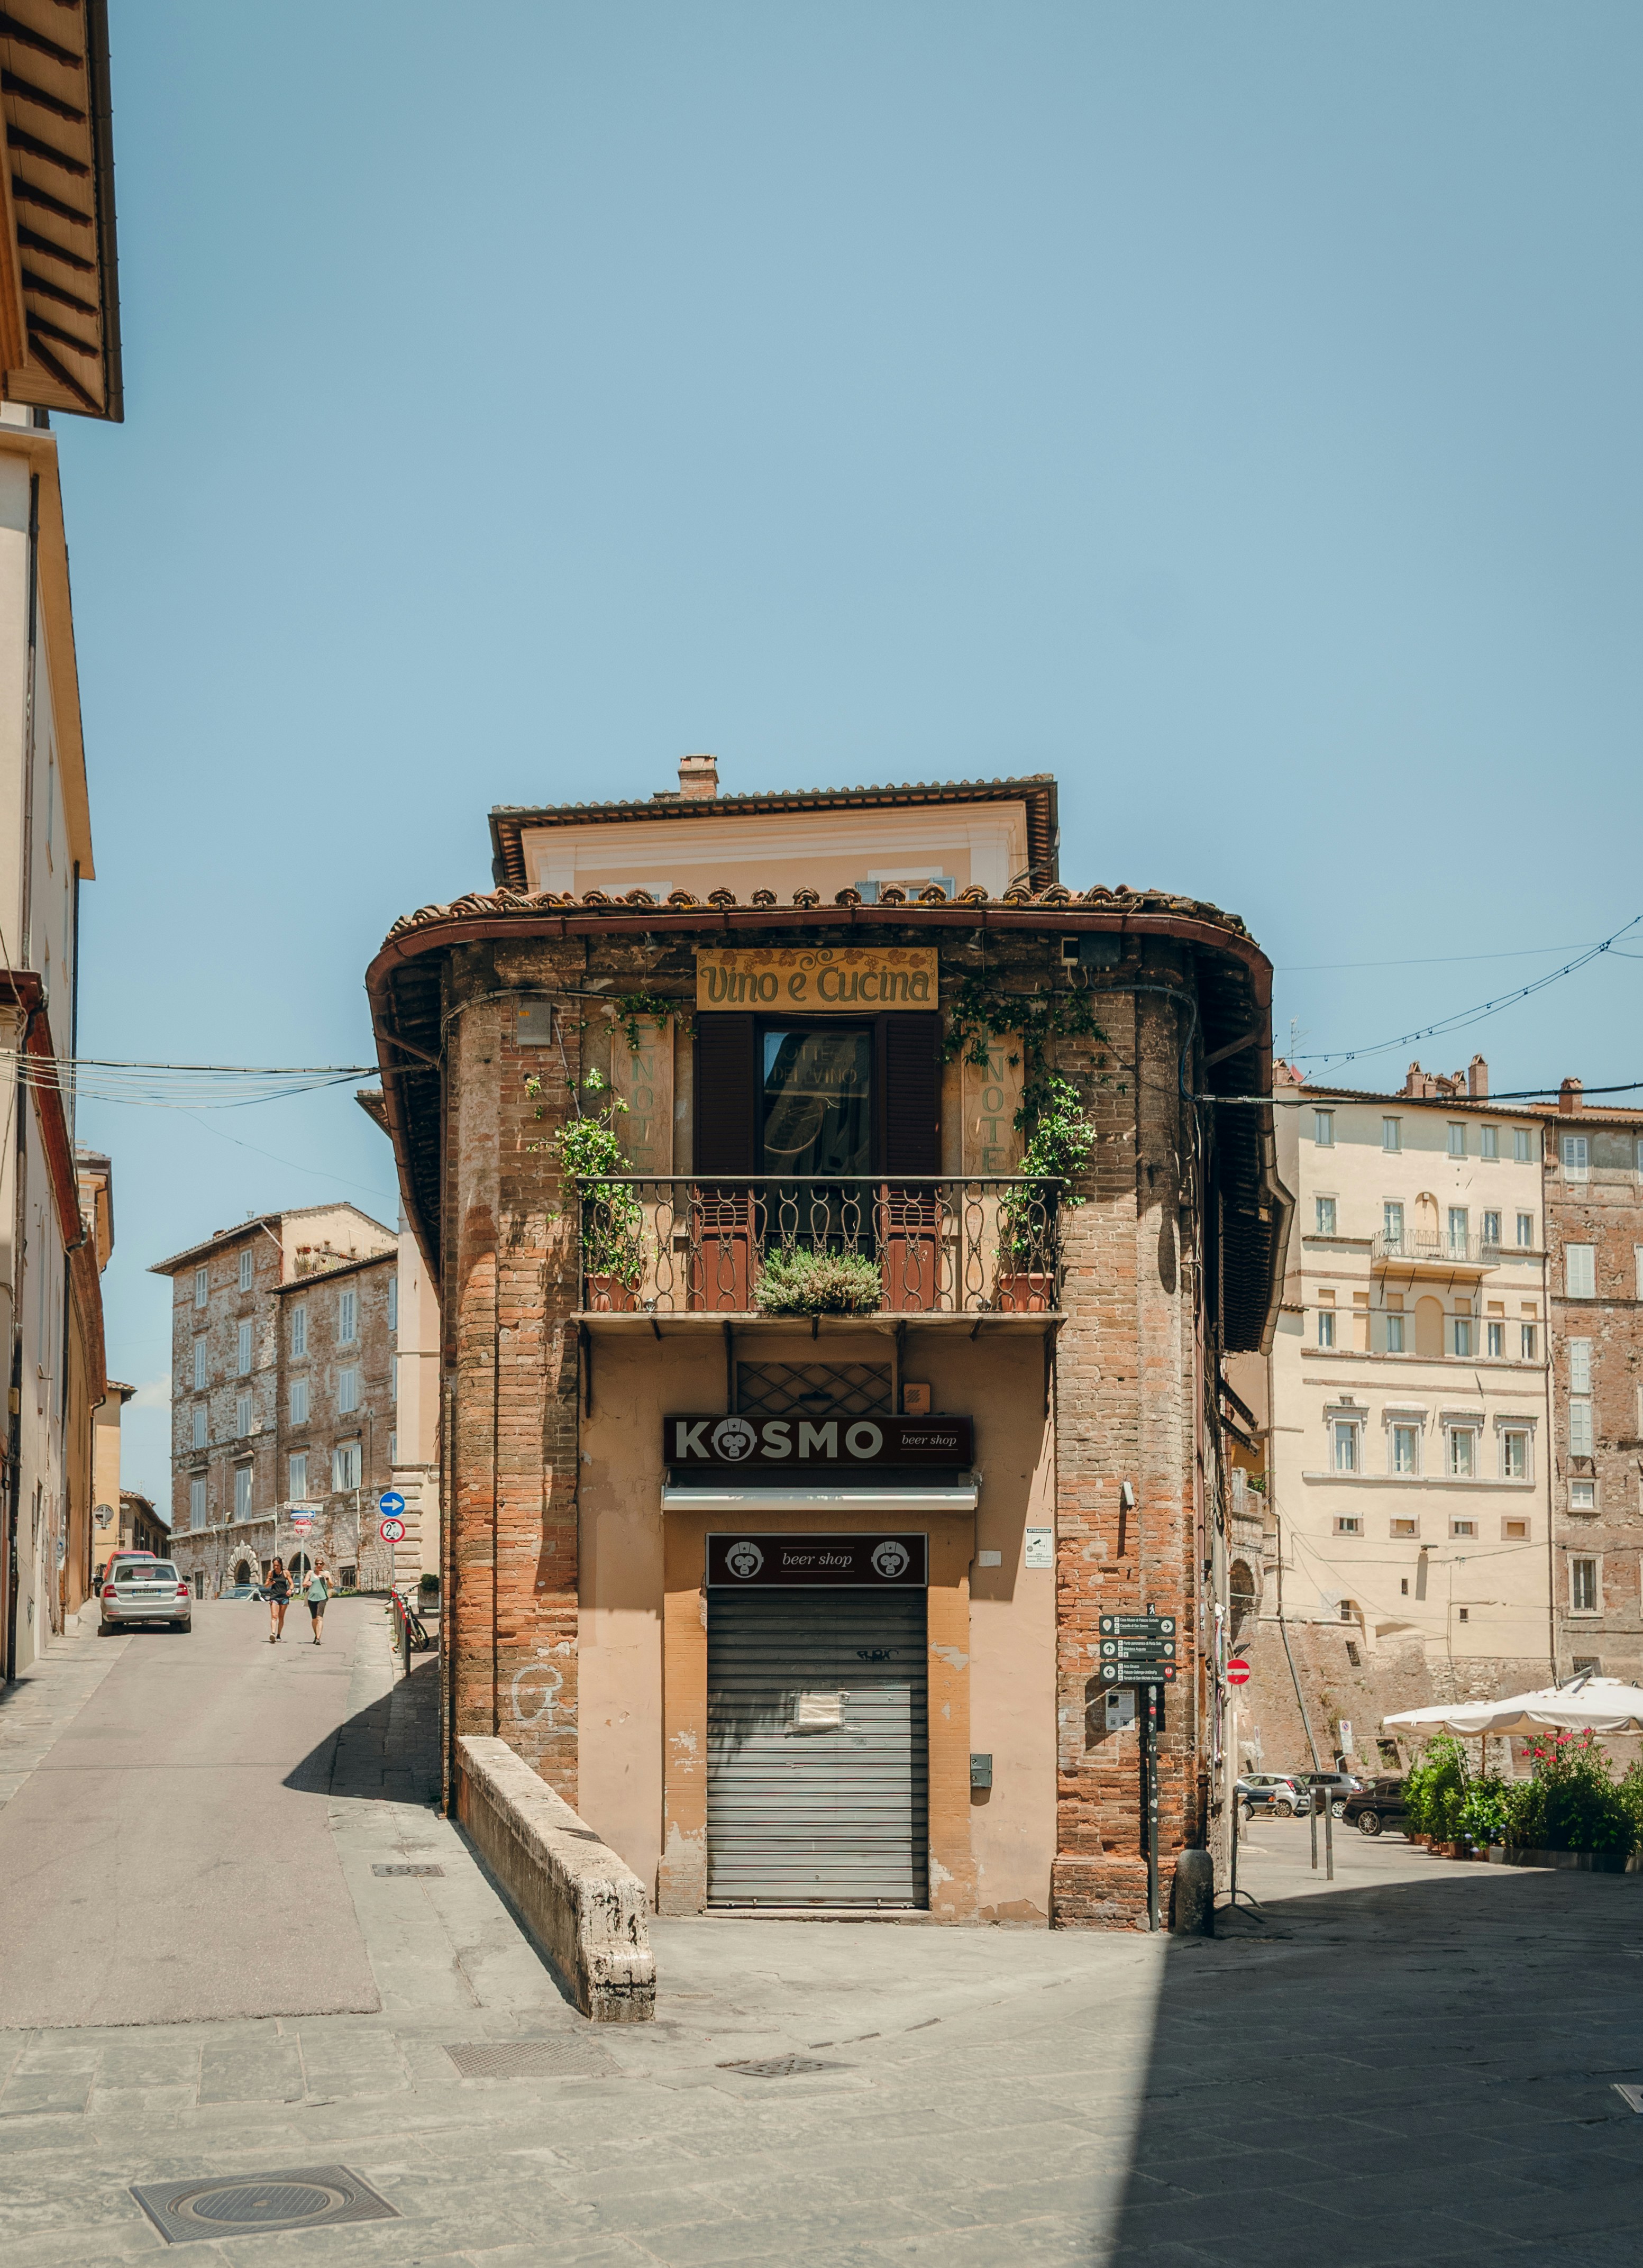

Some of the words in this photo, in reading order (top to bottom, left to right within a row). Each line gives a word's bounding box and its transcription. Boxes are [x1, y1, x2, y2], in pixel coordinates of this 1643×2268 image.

[700, 966, 778, 1003] Vino
[788, 971, 807, 1002] e
[817, 966, 930, 1003] Cucina
[813, 1067, 857, 1085] VINO
[676, 1418, 883, 1461] KOSMO
[902, 1434, 928, 1445] beer
[930, 1434, 956, 1447] shop
[782, 1552, 815, 1565] beer
[818, 1552, 852, 1568] shop
